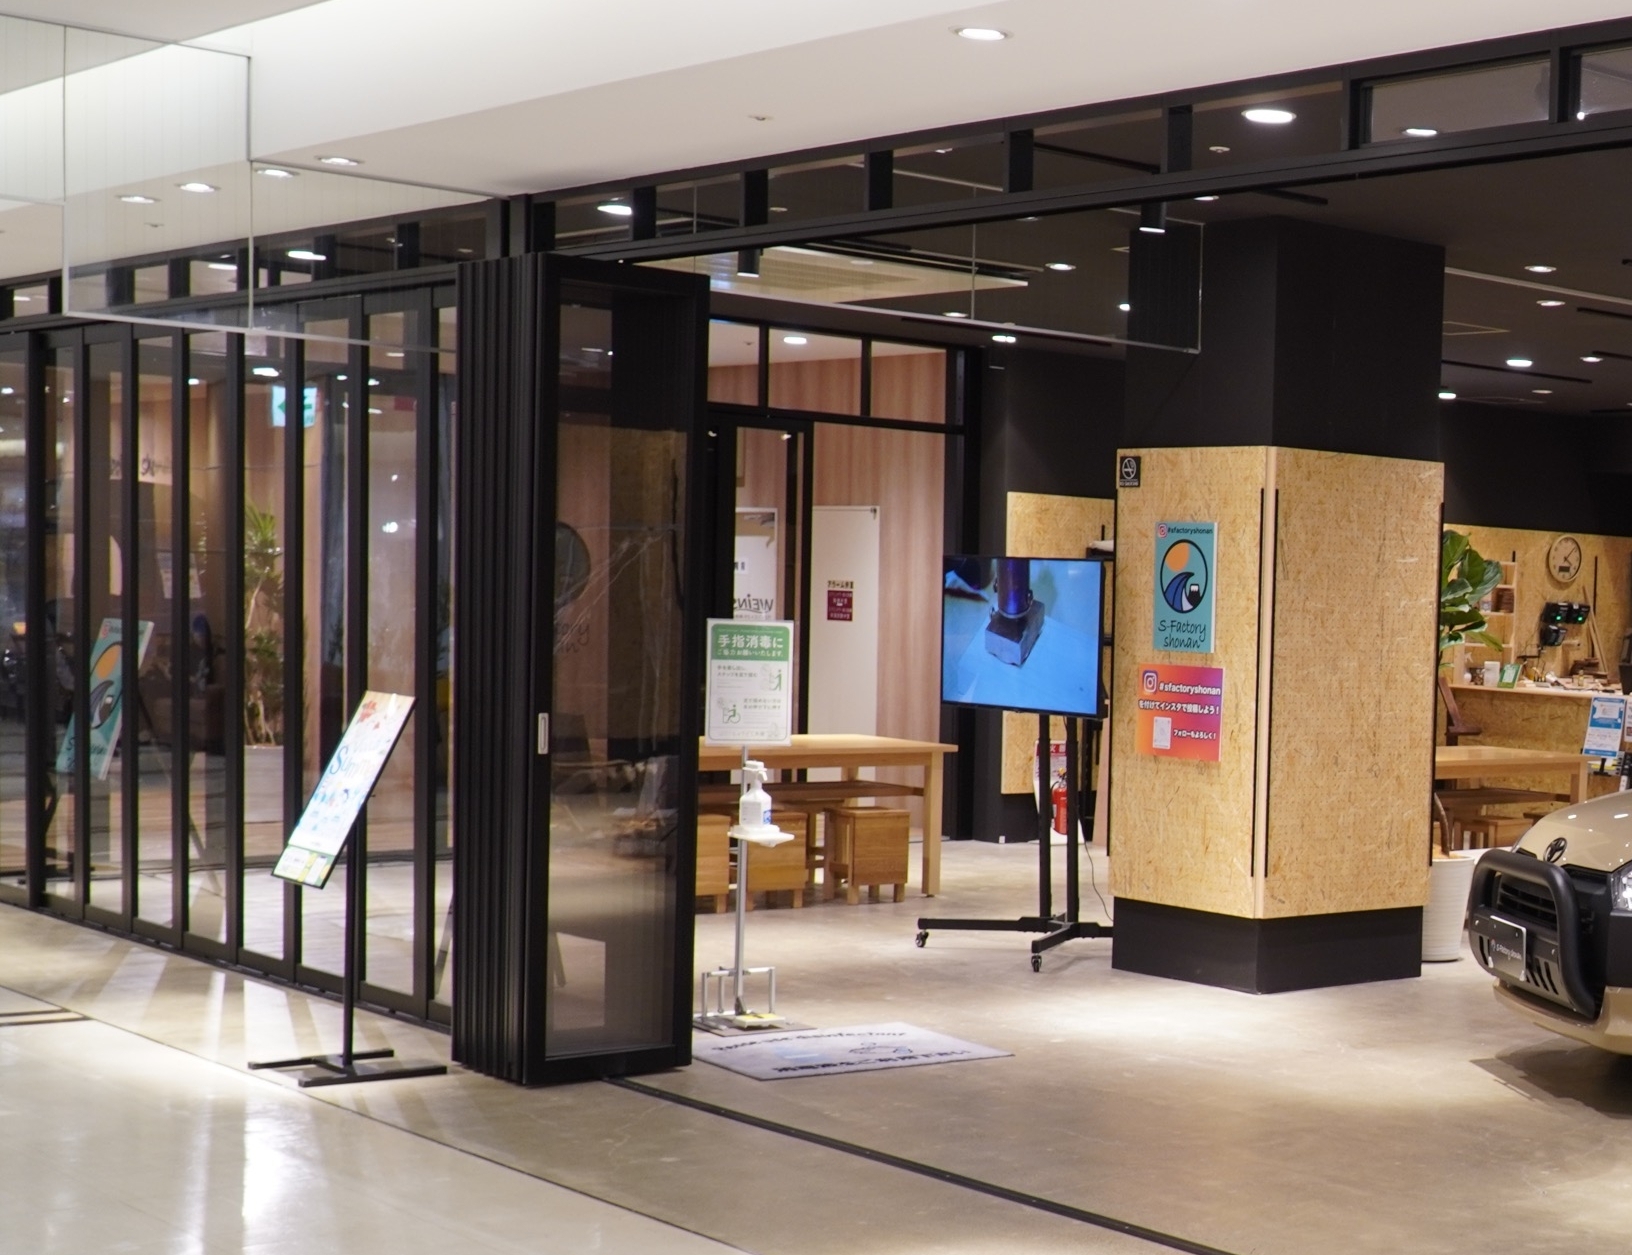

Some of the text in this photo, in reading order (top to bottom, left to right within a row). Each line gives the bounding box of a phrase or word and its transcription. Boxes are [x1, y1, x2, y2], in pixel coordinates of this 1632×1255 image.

[1167, 526, 1213, 535] #sfactoryshonan
[1158, 619, 1207, 642] S-Factory
[718, 634, 784, 649] 手指消毒に
[1163, 636, 1201, 649] shonan
[1159, 682, 1221, 696] #sfactoryshonan
